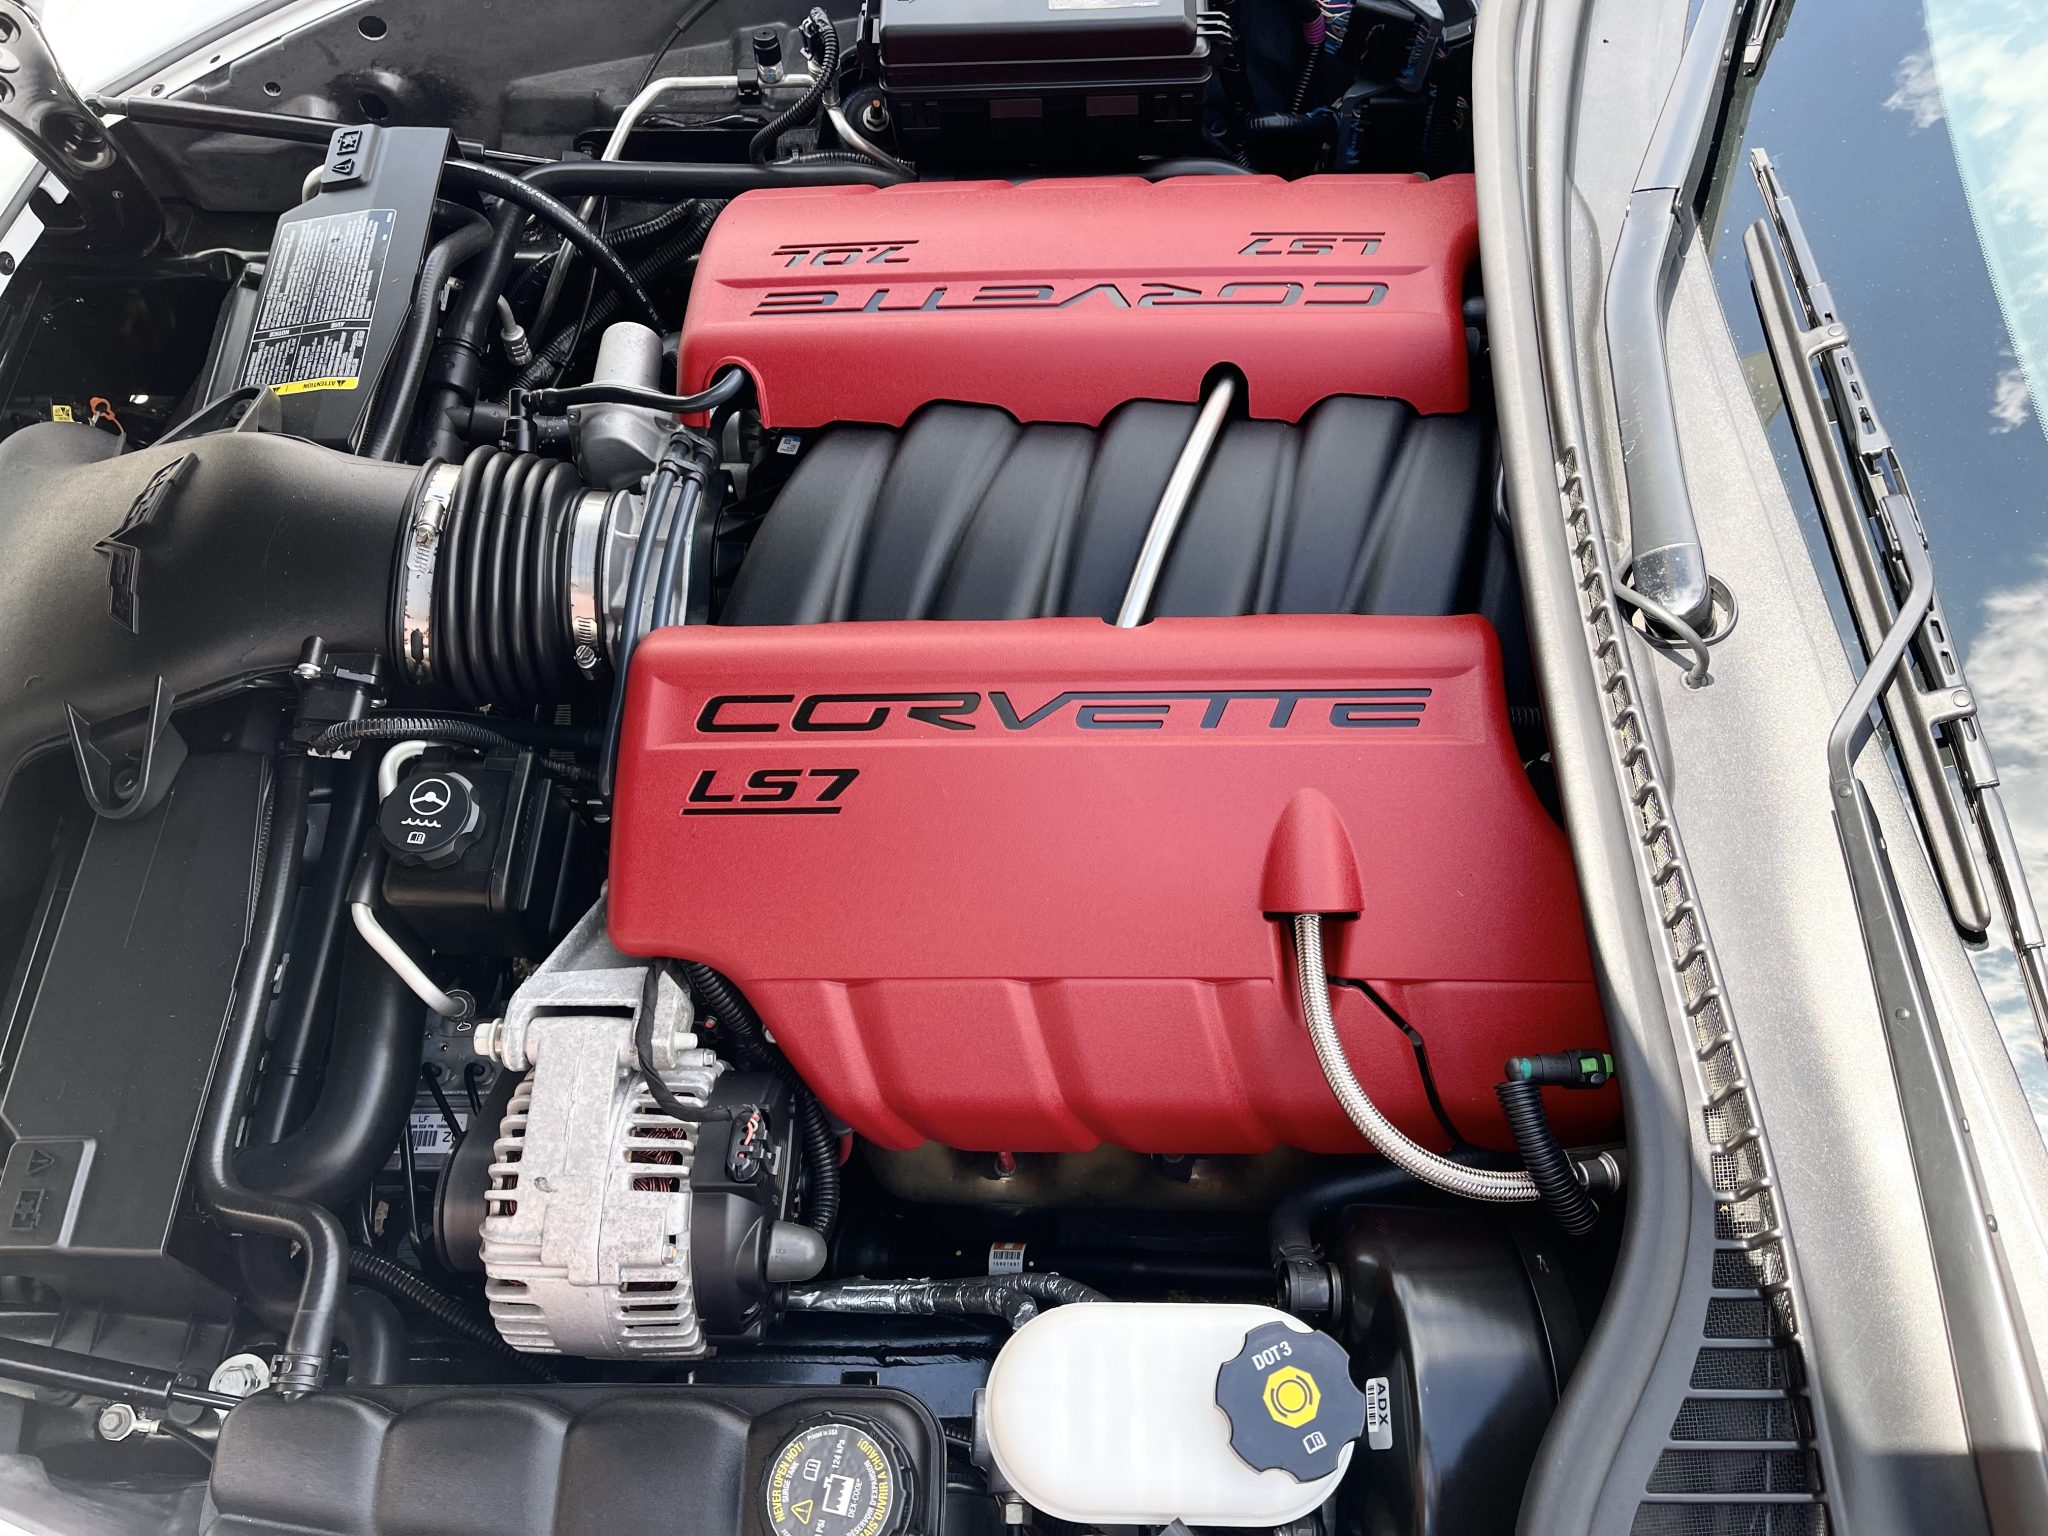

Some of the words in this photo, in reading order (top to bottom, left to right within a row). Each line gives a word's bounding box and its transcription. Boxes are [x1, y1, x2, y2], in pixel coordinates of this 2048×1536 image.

[510, 178, 558, 208] GOODYEAR
[771, 245, 911, 268] 7.0L
[1237, 237, 1383, 256] LS7
[612, 256, 626, 273] HOSE
[750, 281, 1390, 316] CORVETTE
[268, 329, 290, 338] NOTICE
[303, 380, 336, 389] ATTENTION
[695, 688, 1433, 733] CORVETTE
[688, 768, 860, 803] LS7
[1251, 1344, 1281, 1371] DOT
[1280, 1340, 1292, 1356] 3
[1377, 1382, 1389, 1425] ADX
[785, 1441, 805, 1463] HOT!
[832, 1454, 842, 1469] 124
[773, 1460, 790, 1488] OPEN
[786, 1460, 800, 1479] TANK
[782, 1480, 791, 1503] SURGE
[772, 1489, 786, 1523] NEVER
[815, 1519, 826, 1533] PSI
